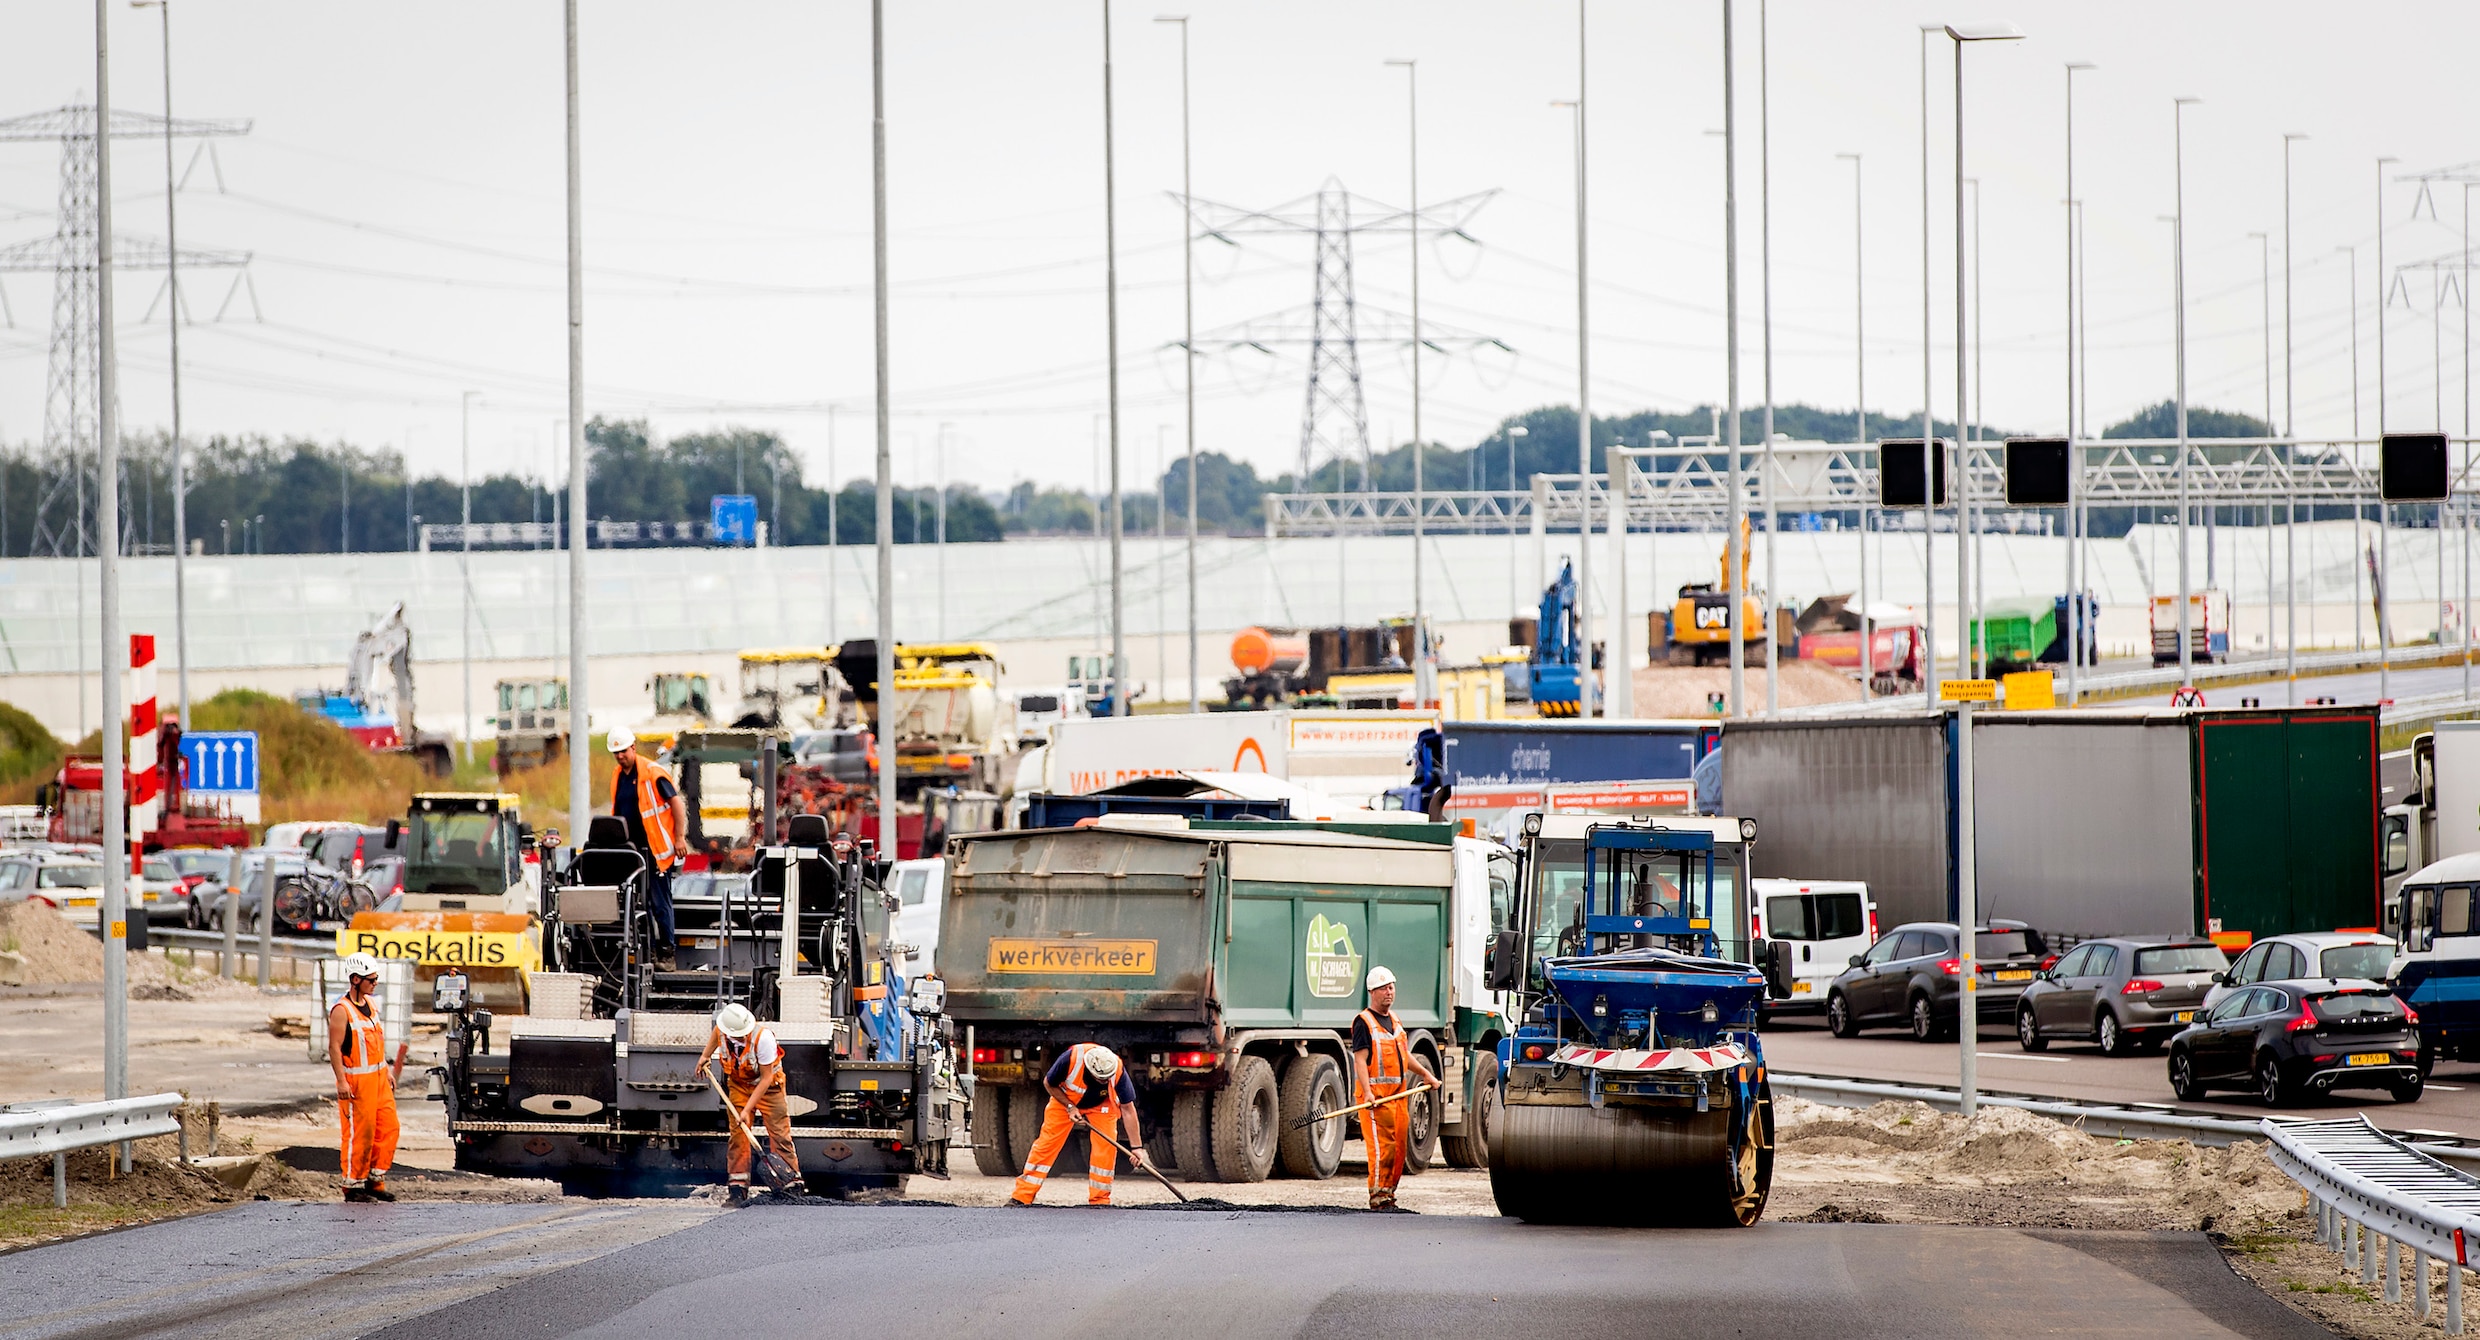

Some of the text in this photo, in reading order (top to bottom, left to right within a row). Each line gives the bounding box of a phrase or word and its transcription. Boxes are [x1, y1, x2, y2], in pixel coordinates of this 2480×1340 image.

[1697, 607, 1727, 628] CAT
[1945, 690, 1992, 698] hoogspanning
[1511, 741, 1550, 771] chemie
[1069, 770, 1107, 795] VAN
[357, 933, 505, 964] Boskalis
[999, 946, 1146, 967] werkverkeer
[2340, 1016, 2389, 1025] VOLVO
